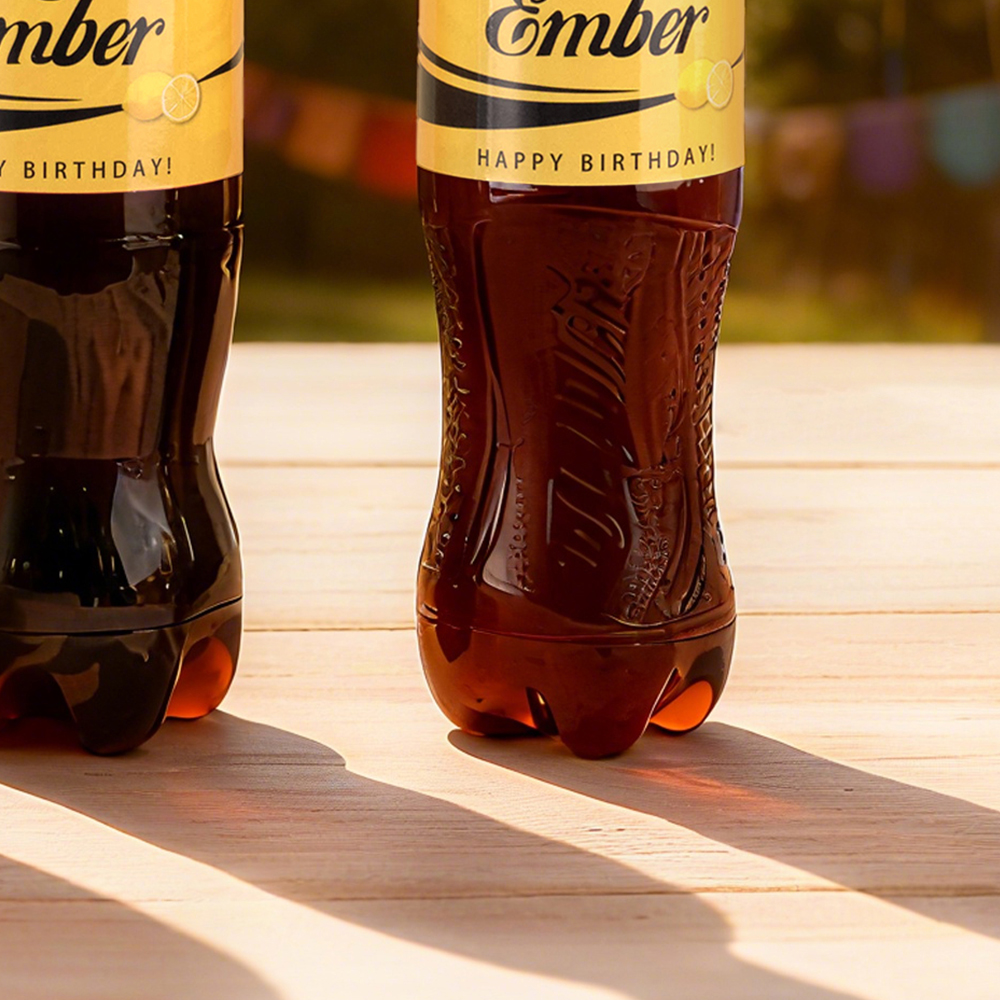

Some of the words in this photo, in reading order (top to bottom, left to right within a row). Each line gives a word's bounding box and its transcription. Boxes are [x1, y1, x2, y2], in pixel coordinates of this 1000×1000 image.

[23, 157, 172, 180] BIRTHDAY!
[478, 148, 564, 172] HAPPY
[581, 143, 716, 173] BIRTHDAY!
